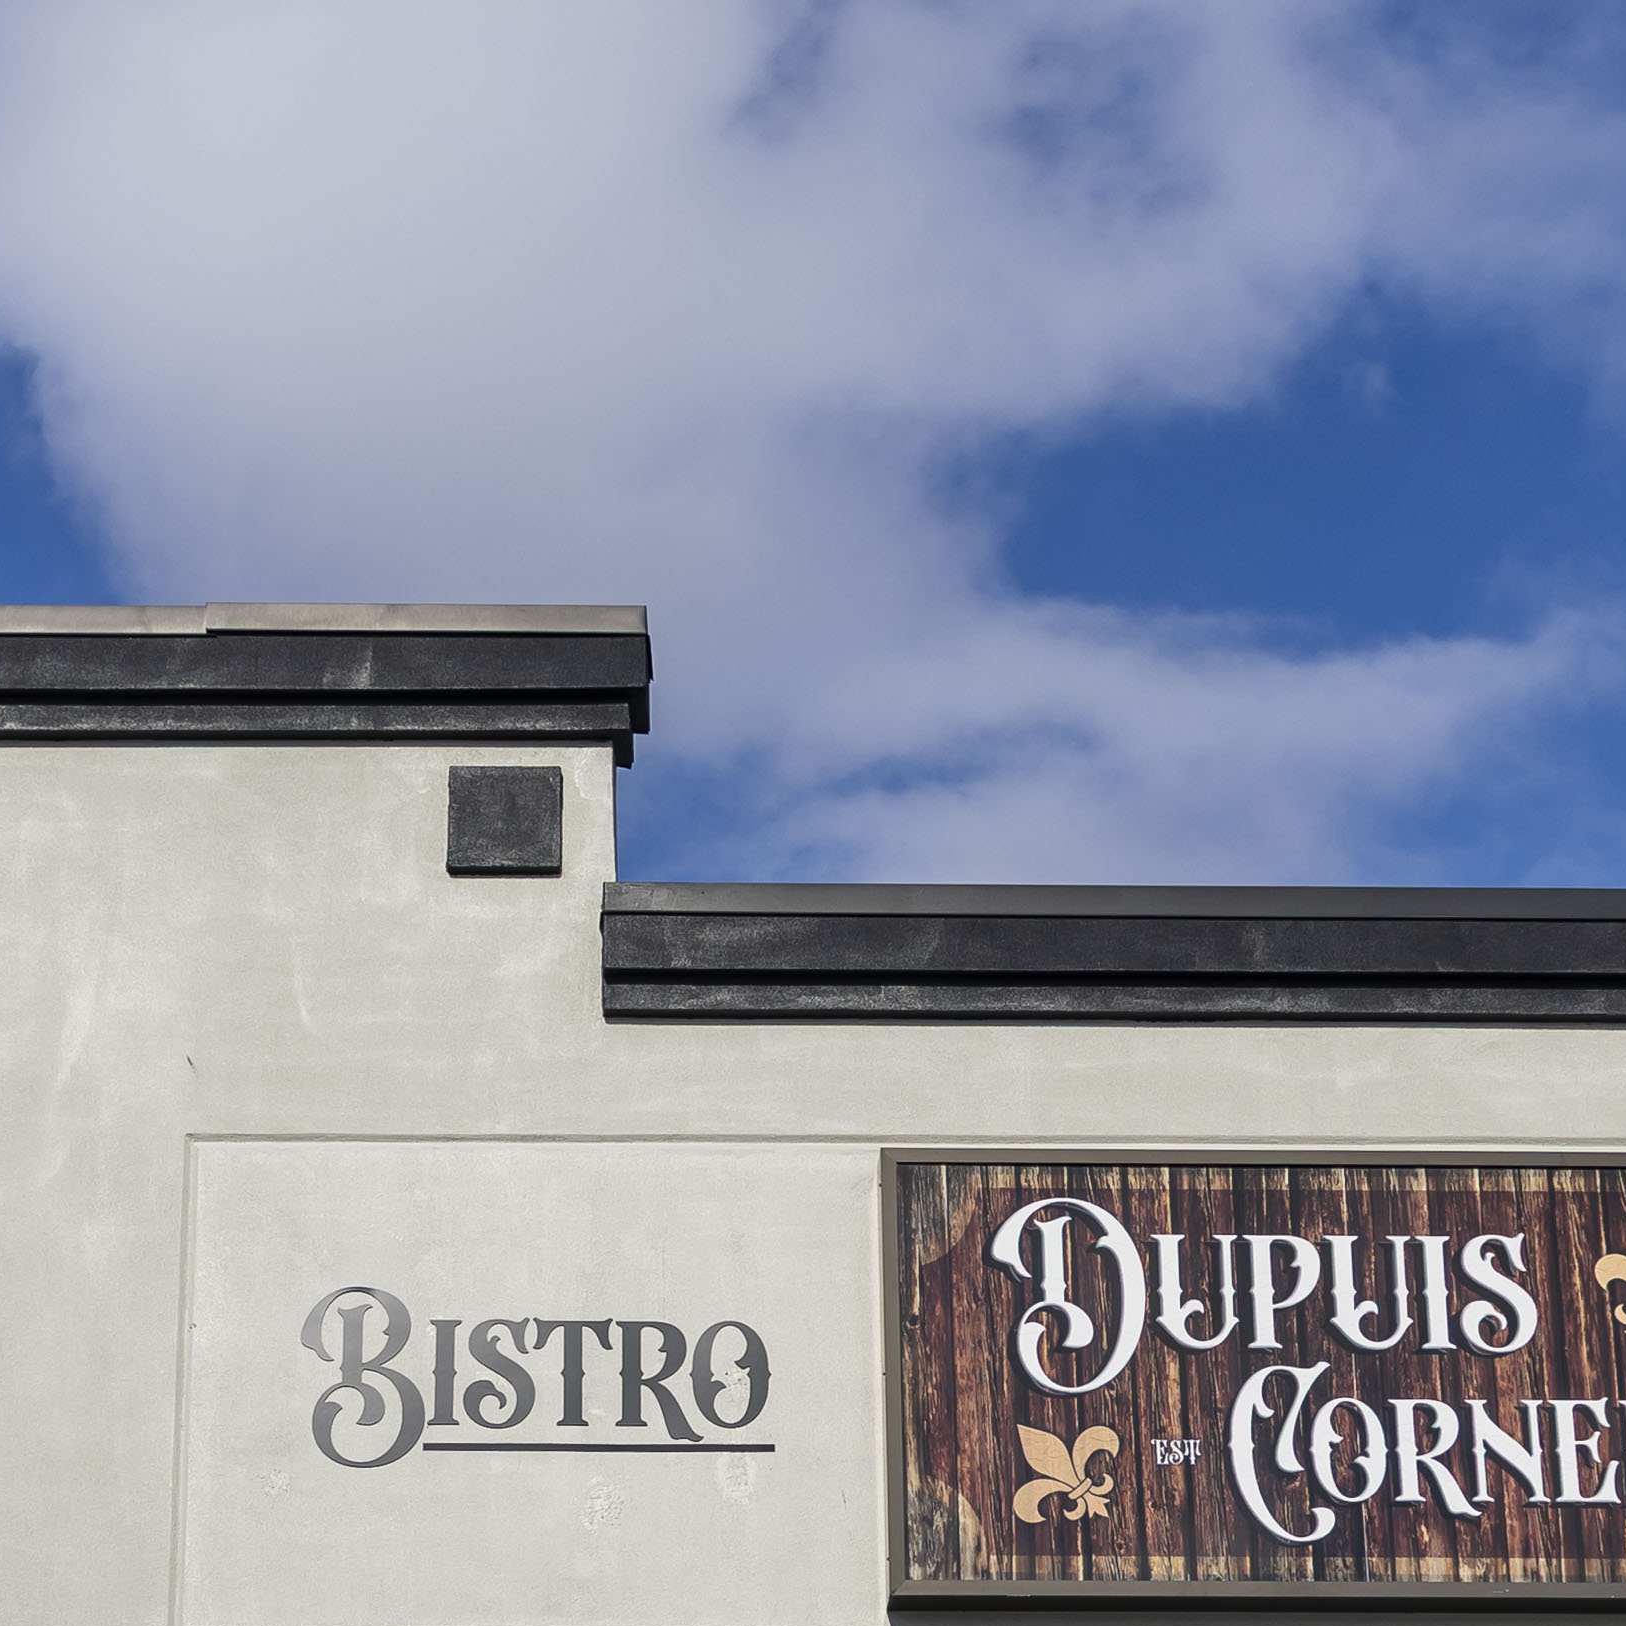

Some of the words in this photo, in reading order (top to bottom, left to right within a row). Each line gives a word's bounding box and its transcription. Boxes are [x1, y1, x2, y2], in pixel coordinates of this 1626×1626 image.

[300, 1286, 771, 1468] BISTRO
[987, 1196, 1540, 1396] DUPUIS
[1151, 1439, 1201, 1465] EST
